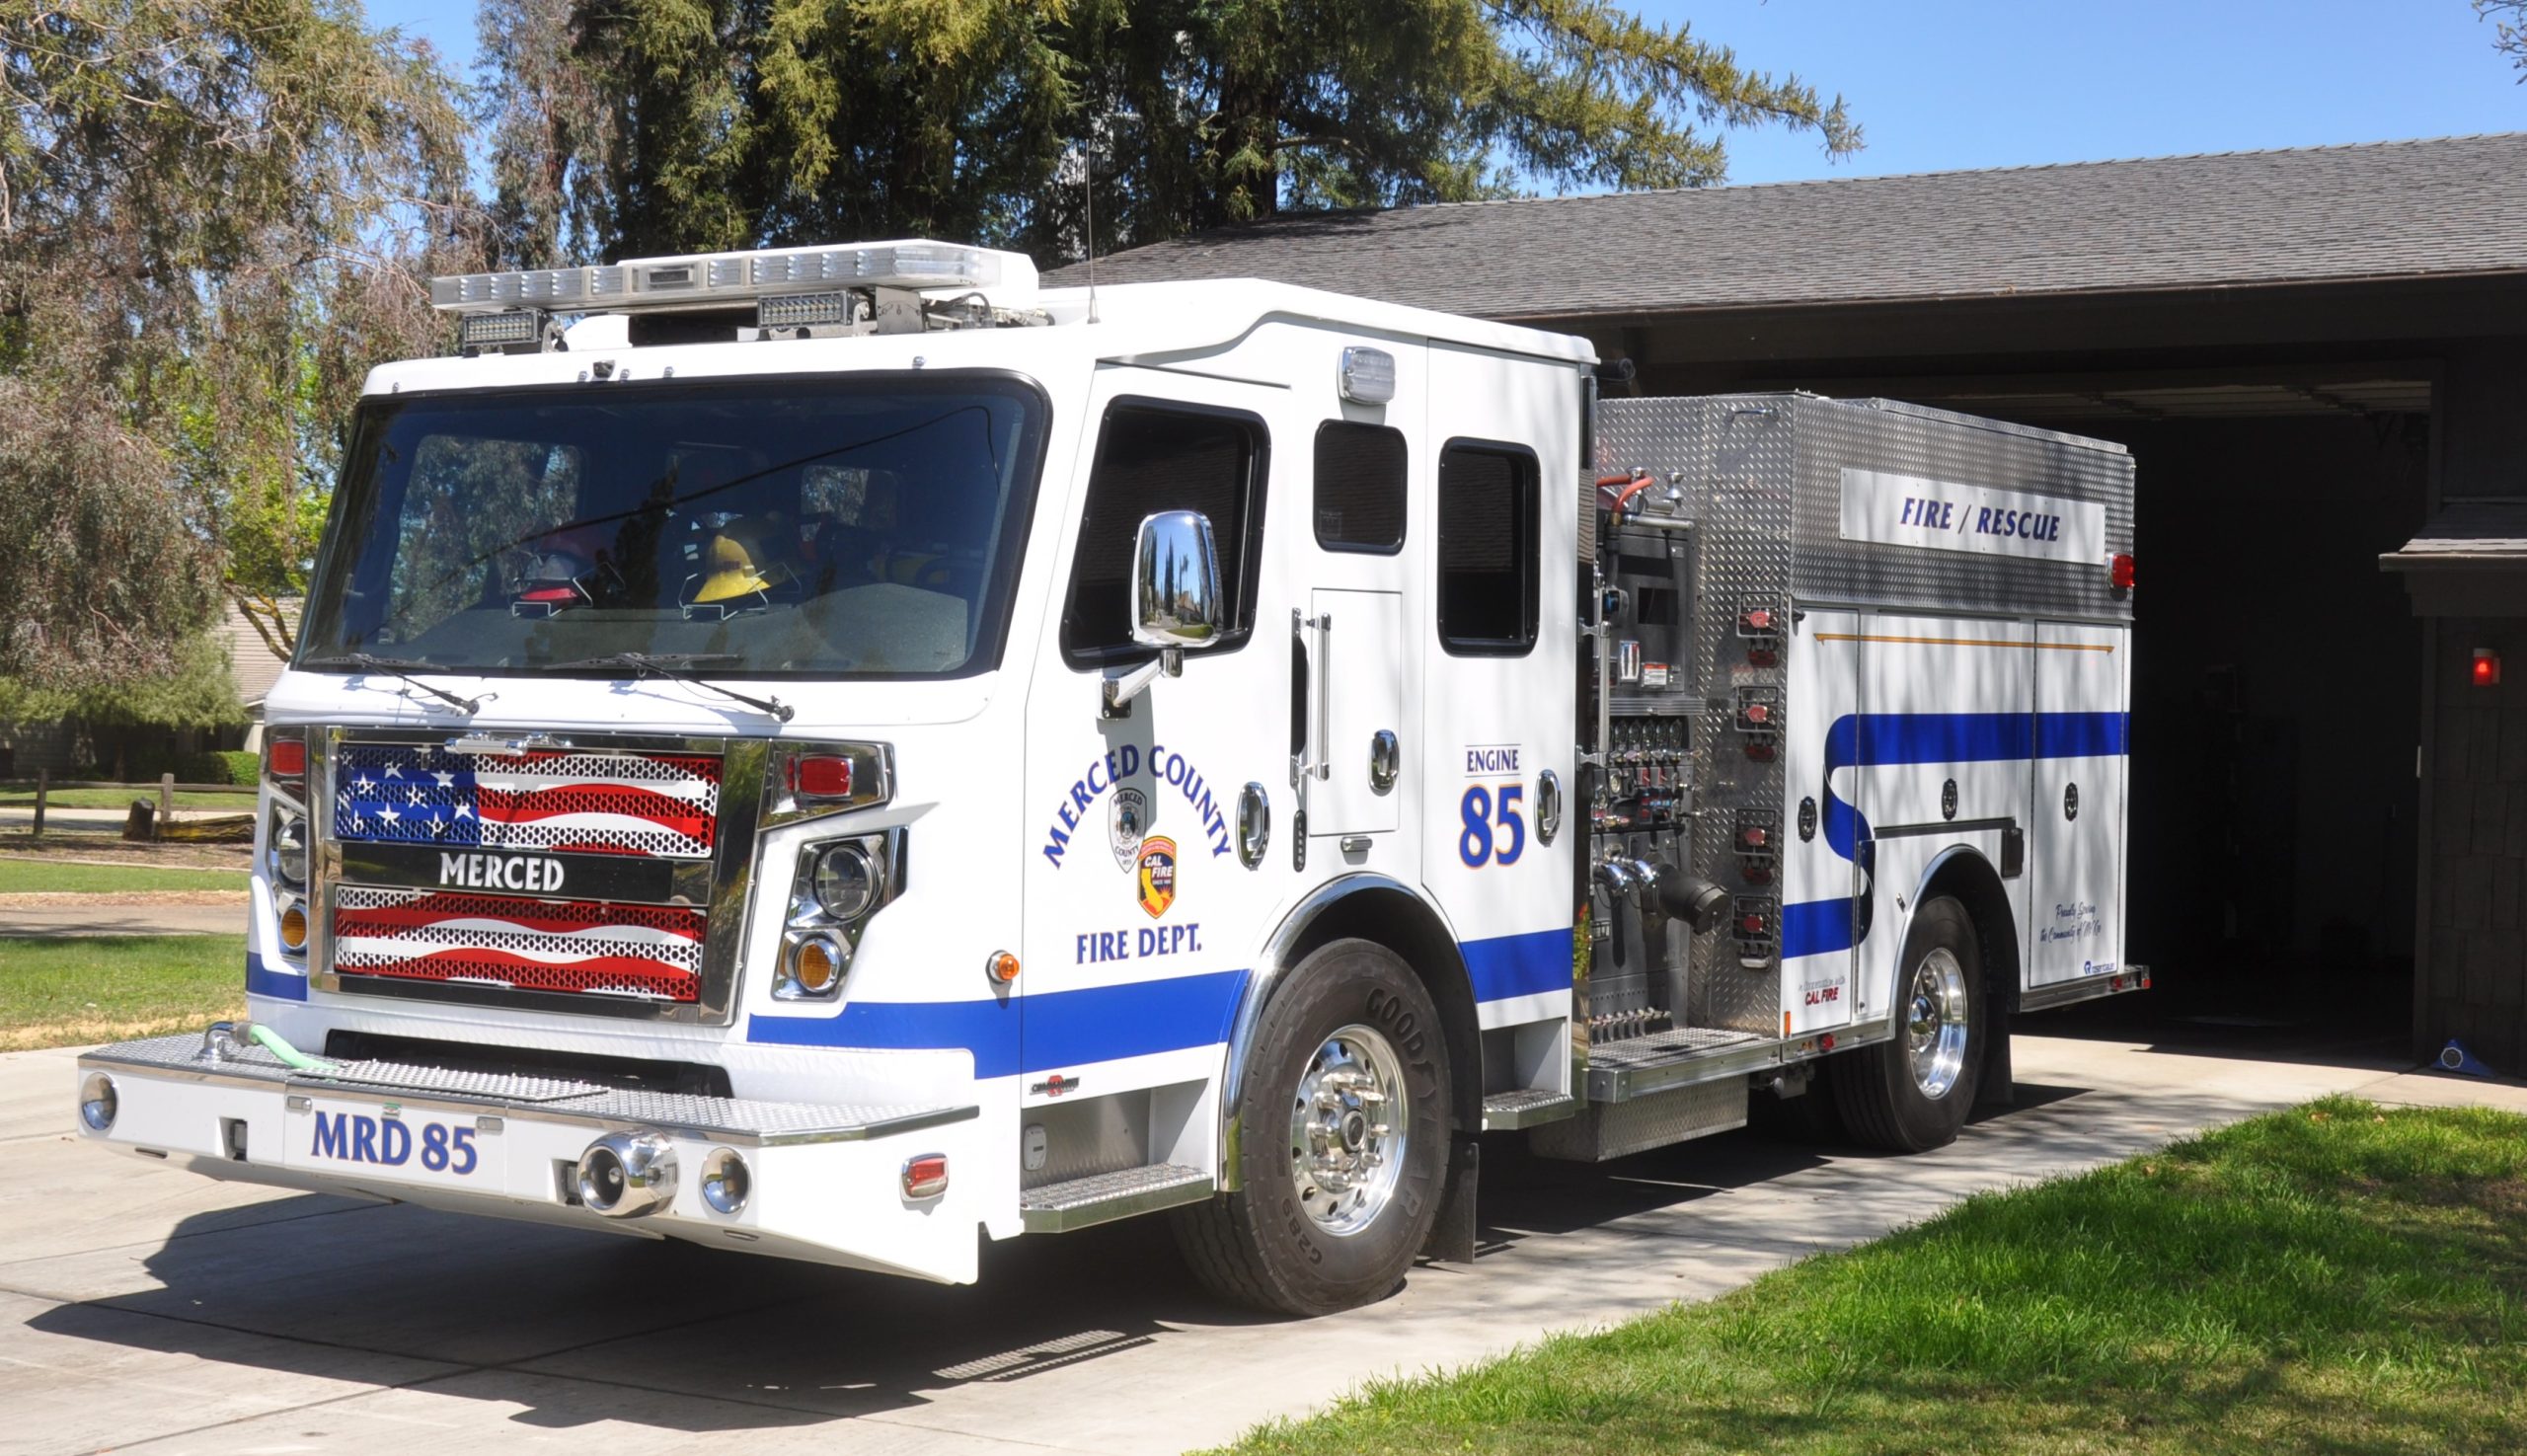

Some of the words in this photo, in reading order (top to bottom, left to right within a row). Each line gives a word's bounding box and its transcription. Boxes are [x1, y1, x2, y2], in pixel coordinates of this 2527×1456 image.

[1900, 497, 1953, 530] FIRE
[1975, 506, 2060, 542] RESCUE
[1467, 749, 1519, 772] ENGINE
[1042, 743, 1139, 870] MERCED
[1148, 745, 1232, 859] COUNTY
[1113, 791, 1143, 806] MERCED
[1459, 784, 1525, 870] 85
[1114, 844, 1139, 857] COUNTY
[1145, 855, 1163, 868] CAL
[439, 852, 566, 892] MERCED
[1151, 866, 1174, 879] FIRE
[1076, 930, 1130, 964] FIRE
[1138, 923, 1202, 958] DEPT.
[1805, 991, 1820, 1006] CAL
[1821, 987, 1839, 1004] FIRE
[311, 1110, 412, 1167] MRD
[421, 1122, 478, 1175] 85
